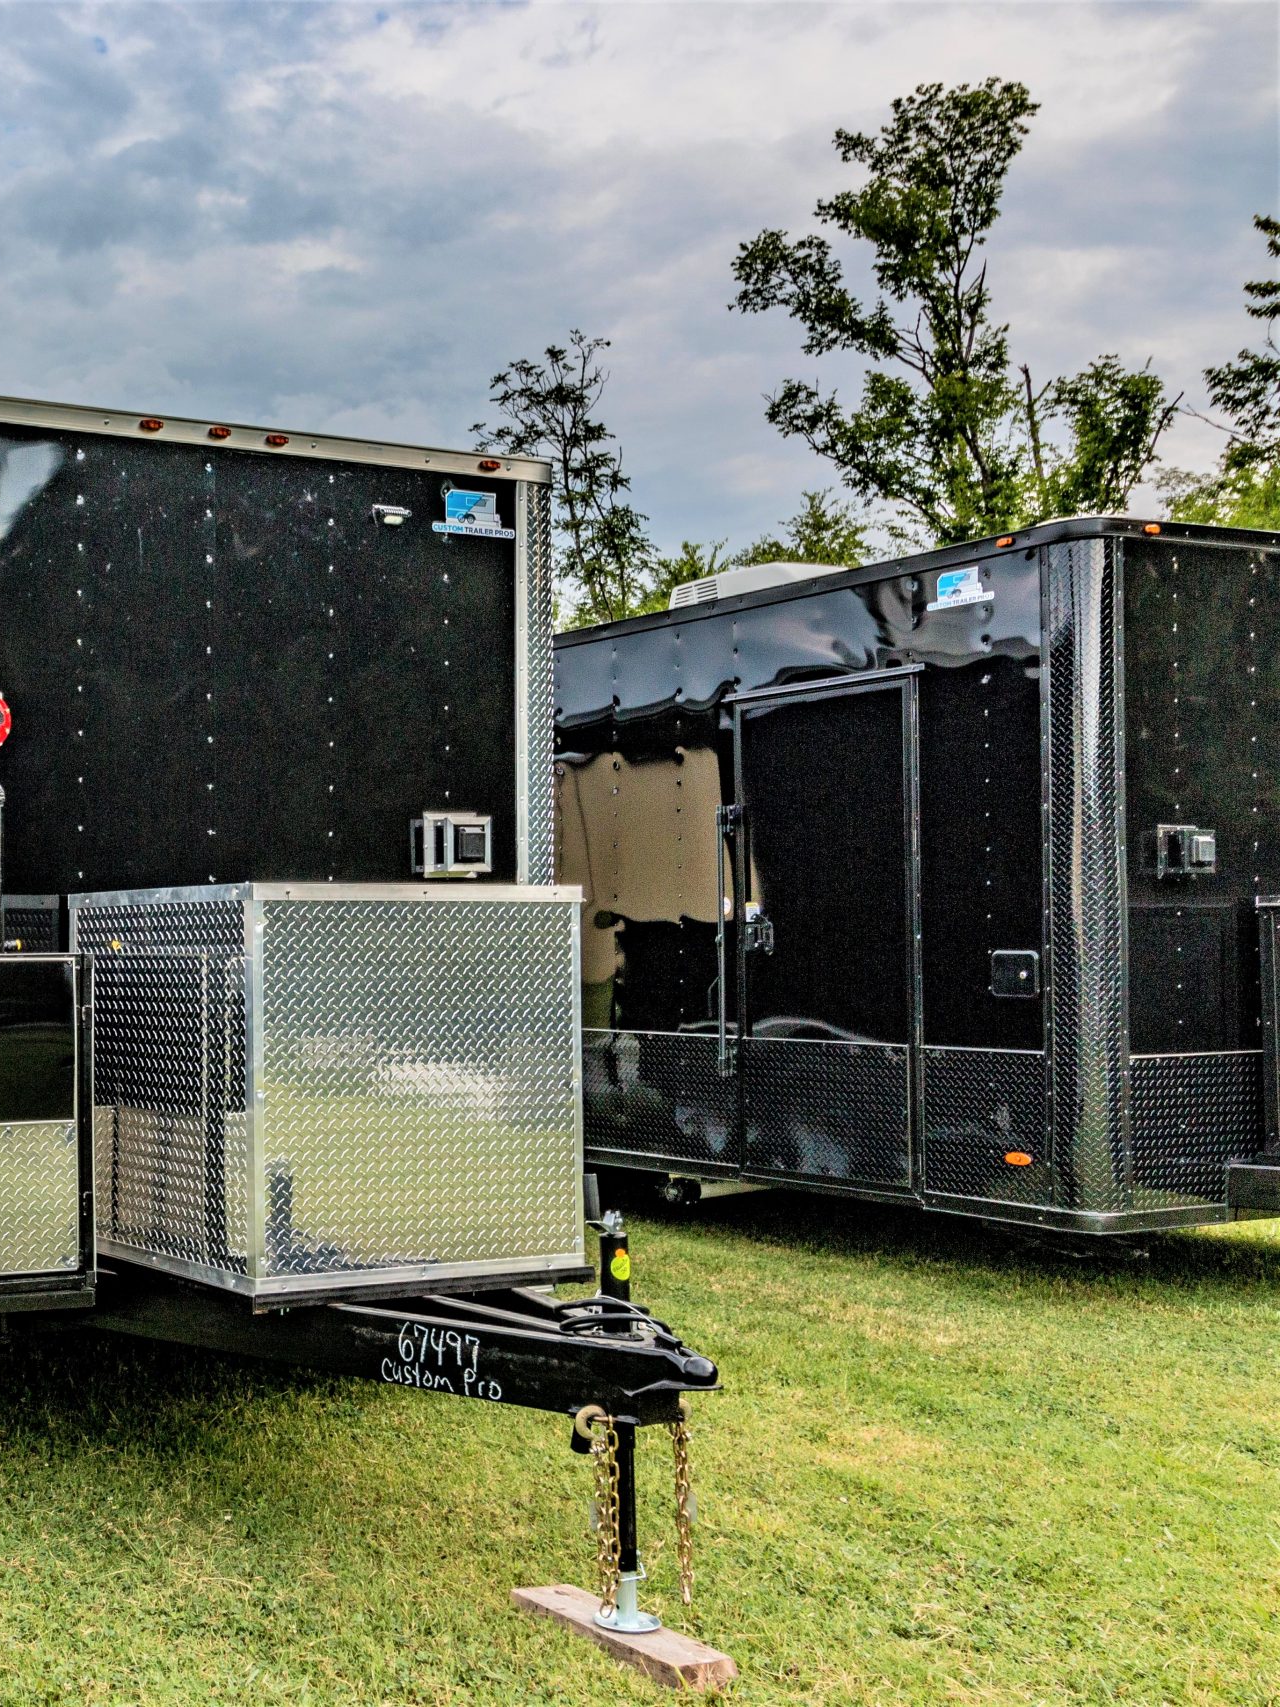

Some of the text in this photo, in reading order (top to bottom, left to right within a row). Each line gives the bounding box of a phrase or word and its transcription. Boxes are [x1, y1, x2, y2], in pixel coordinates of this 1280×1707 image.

[433, 523, 514, 538] CUSTOM TRAILER PROS
[398, 1321, 480, 1372] 67497
[463, 1367, 502, 1400] Pro
